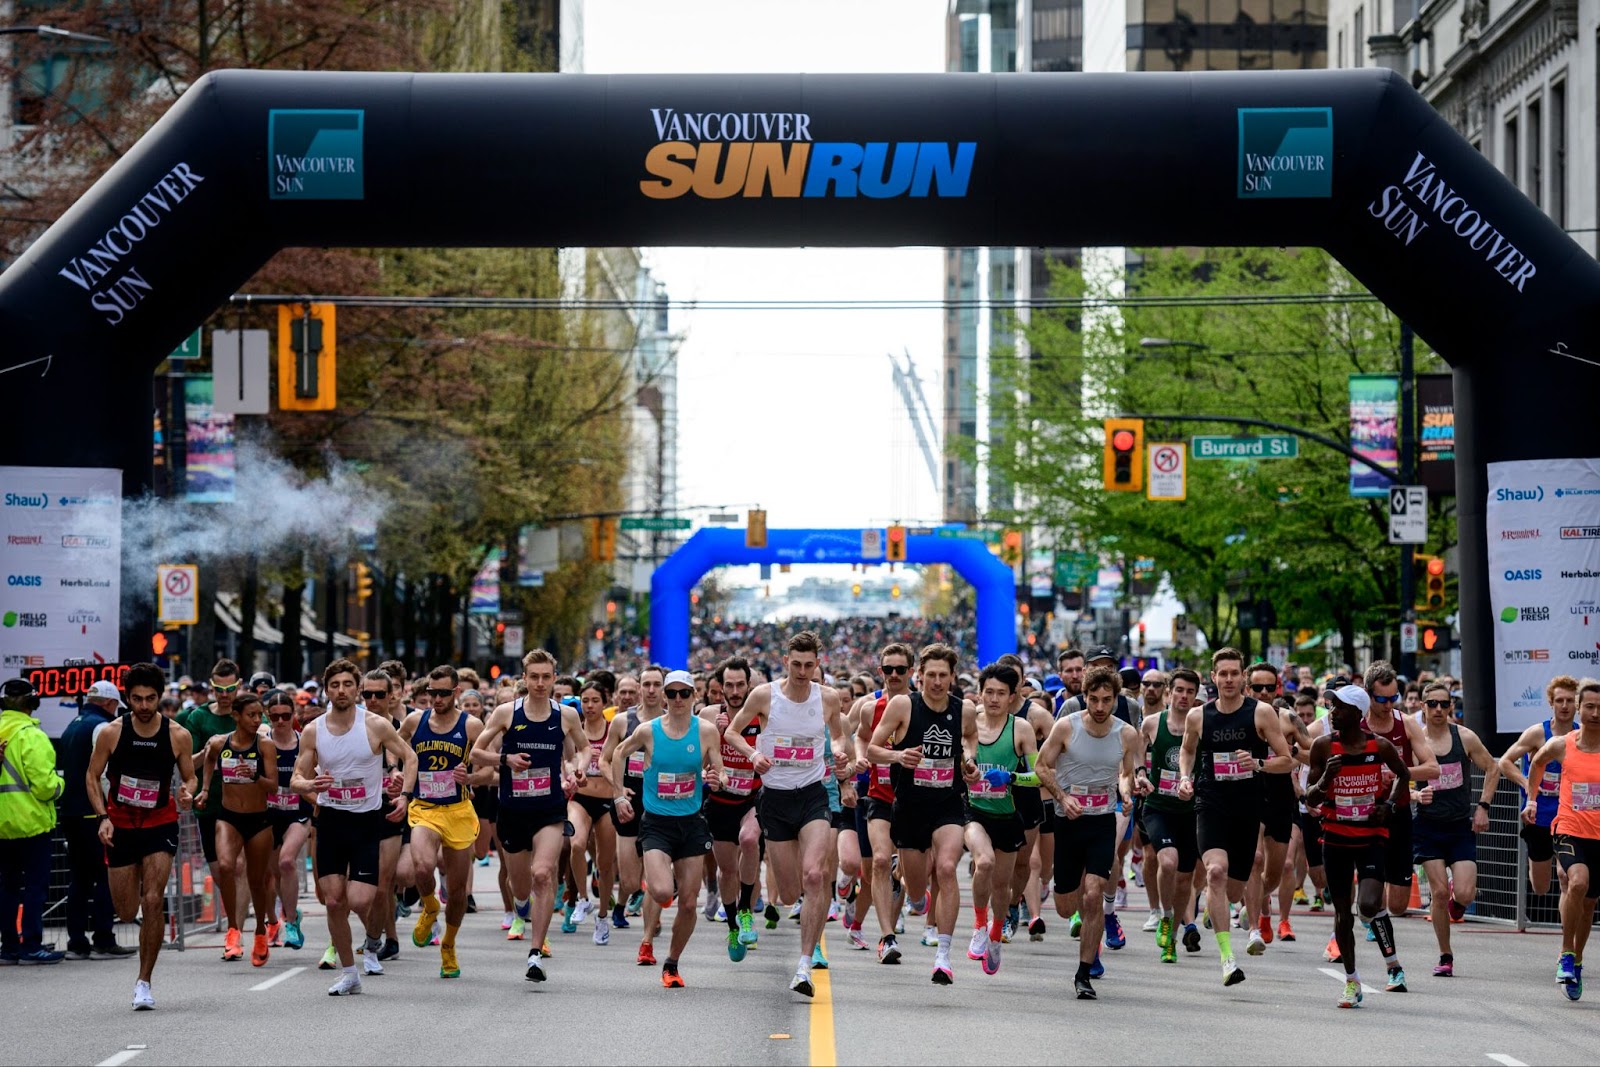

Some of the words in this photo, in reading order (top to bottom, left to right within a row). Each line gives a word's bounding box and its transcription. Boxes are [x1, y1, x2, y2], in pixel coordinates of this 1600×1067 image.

[650, 108, 813, 141] VANCOUVER
[275, 154, 355, 173] VANCOUVER
[1246, 153, 1325, 172] VANCOUVER
[276, 174, 304, 193] SUN
[1245, 174, 1272, 192] SUN
[1367, 185, 1429, 247] SUN
[58, 161, 205, 292] VANCOUVER
[1402, 151, 1537, 293] VANCOUVER
[91, 266, 153, 327] SUN
[1201, 440, 1262, 455] Burrard
[1270, 439, 1289, 454] St
[7, 575, 42, 586] OASIS
[1504, 569, 1542, 581] OASIS
[1520, 606, 1549, 614] HELLO
[68, 615, 101, 623] ULTRA
[1568, 650, 1599, 659] Global
[132, 741, 158, 749] saucony
[416, 740, 463, 757] COLLINGWOOD
[516, 742, 556, 750] THUNDERBIRDS
[790, 749, 797, 760] 2
[427, 755, 449, 770] 29
[1228, 763, 1239, 774] 71
[931, 770, 938, 781] 3
[528, 780, 535, 790] 8
[730, 778, 740, 788] 17
[981, 782, 992, 793] 12
[340, 789, 351, 799] 10
[674, 784, 681, 794] 4
[134, 790, 142, 800] 6
[277, 796, 289, 806] 30
[1085, 797, 1093, 807] 5
[1352, 806, 1359, 816] 9
